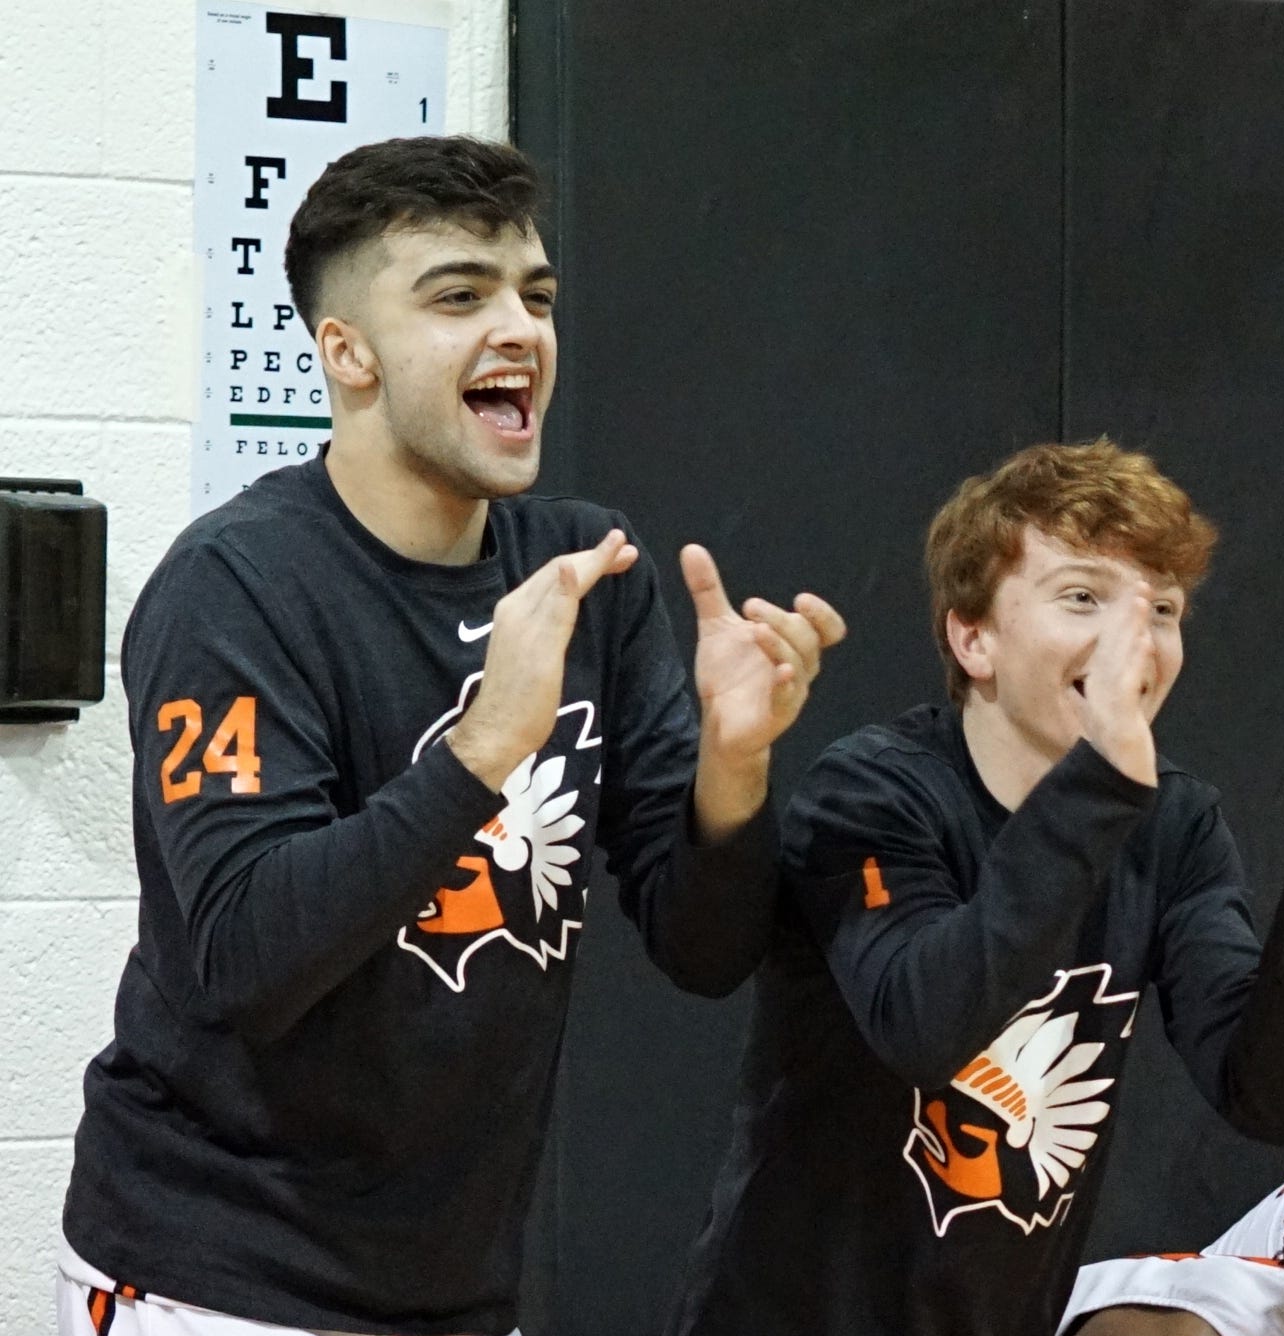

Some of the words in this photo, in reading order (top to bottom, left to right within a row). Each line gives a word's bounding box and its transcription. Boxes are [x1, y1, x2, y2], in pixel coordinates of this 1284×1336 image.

[266, 12, 347, 123] E
[419, 97, 427, 123] 1
[245, 155, 286, 209] F
[232, 237, 261, 275] T
[158, 696, 260, 804] 24
